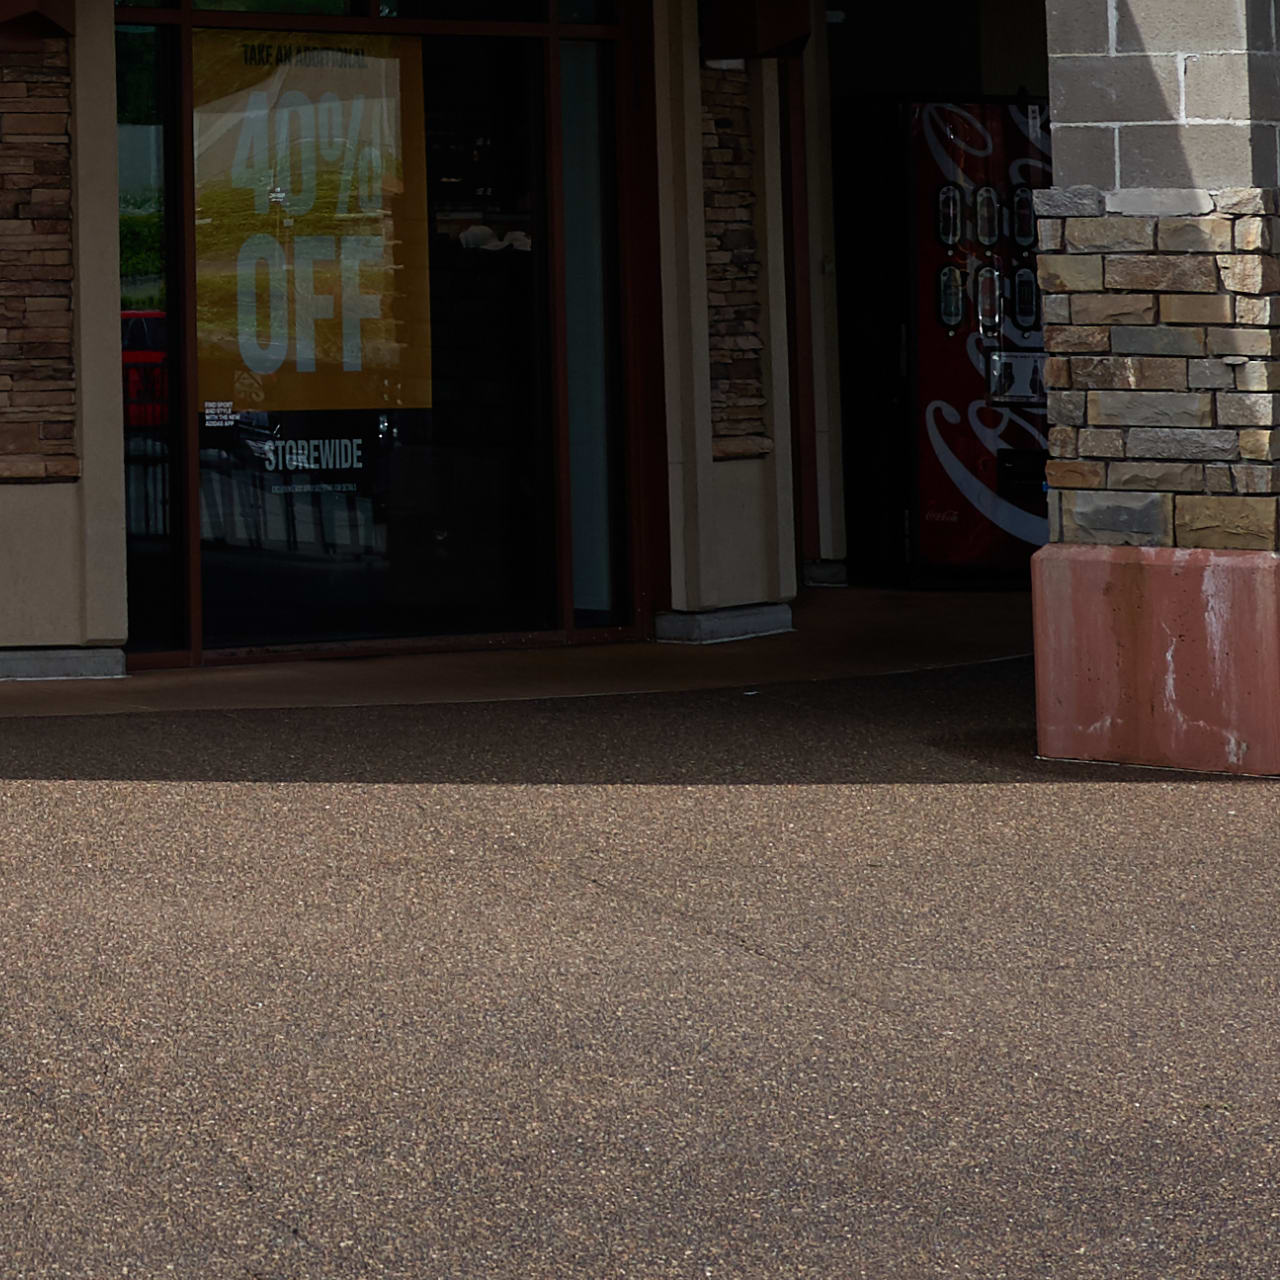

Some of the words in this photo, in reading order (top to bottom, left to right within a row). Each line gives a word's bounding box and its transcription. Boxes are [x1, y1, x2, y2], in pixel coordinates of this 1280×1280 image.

[243, 43, 272, 66] TAKE
[276, 44, 292, 67] AN
[295, 45, 368, 69] ADDITIONAL
[231, 89, 383, 217] 40%
[236, 233, 384, 375] OFF
[264, 438, 363, 471] STOREWIDE
